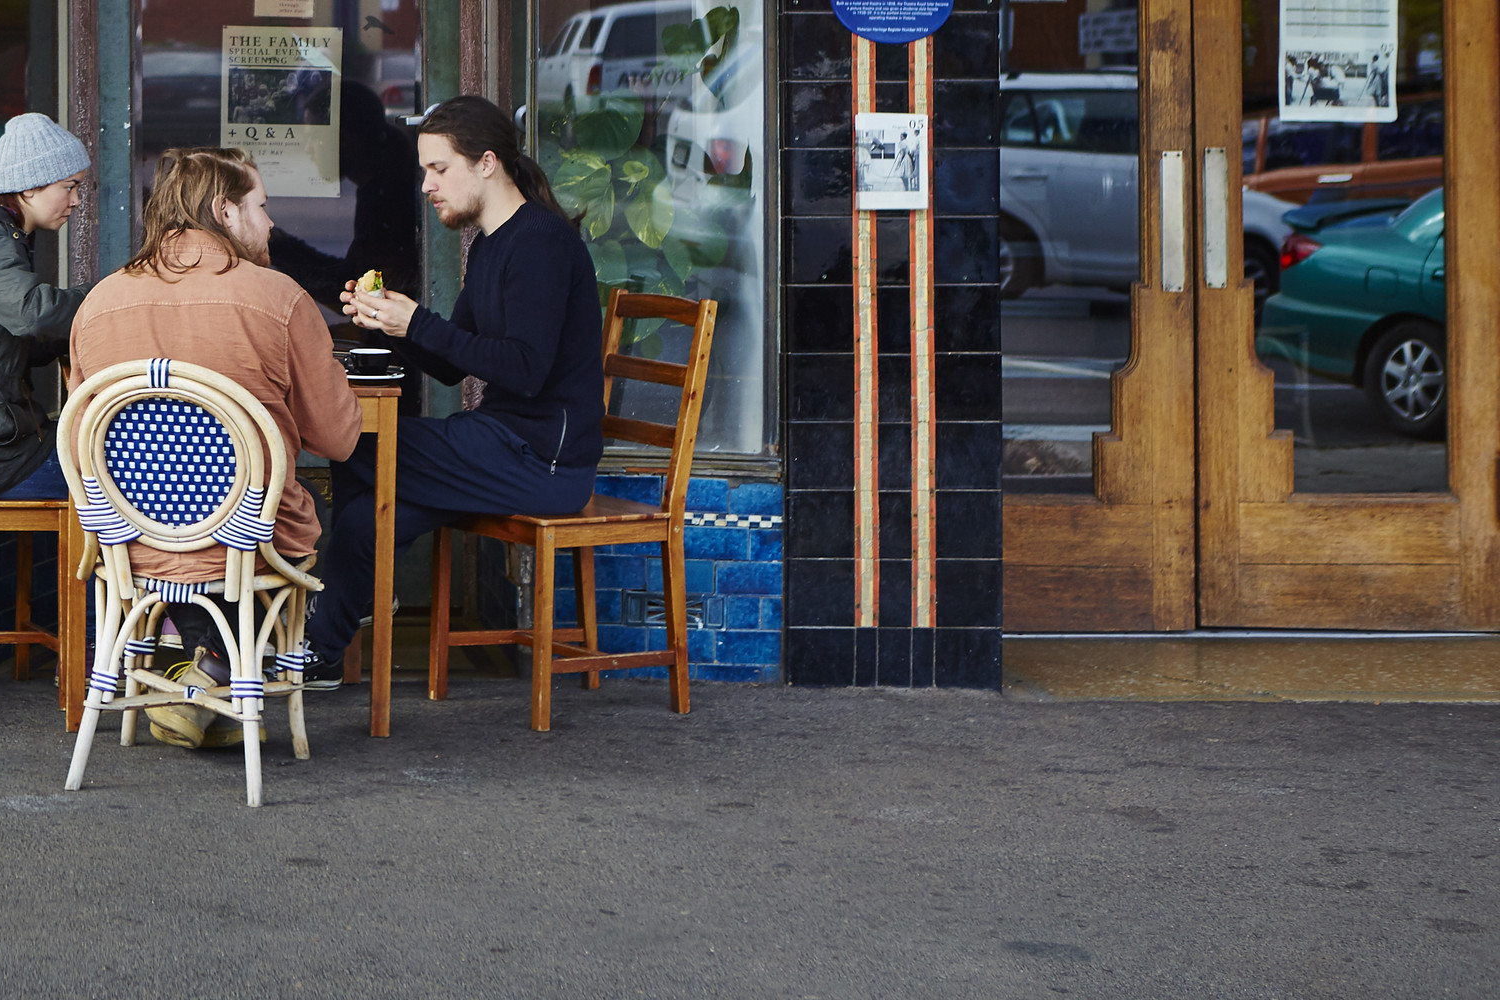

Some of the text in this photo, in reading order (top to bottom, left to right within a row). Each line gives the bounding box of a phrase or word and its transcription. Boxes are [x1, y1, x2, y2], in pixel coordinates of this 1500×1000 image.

[229, 36, 331, 48] THE FAMILY
[275, 48, 308, 56] EVENT
[229, 56, 287, 64] SCREENING
[909, 120, 924, 129] 05
[228, 126, 295, 140] + Q & A
